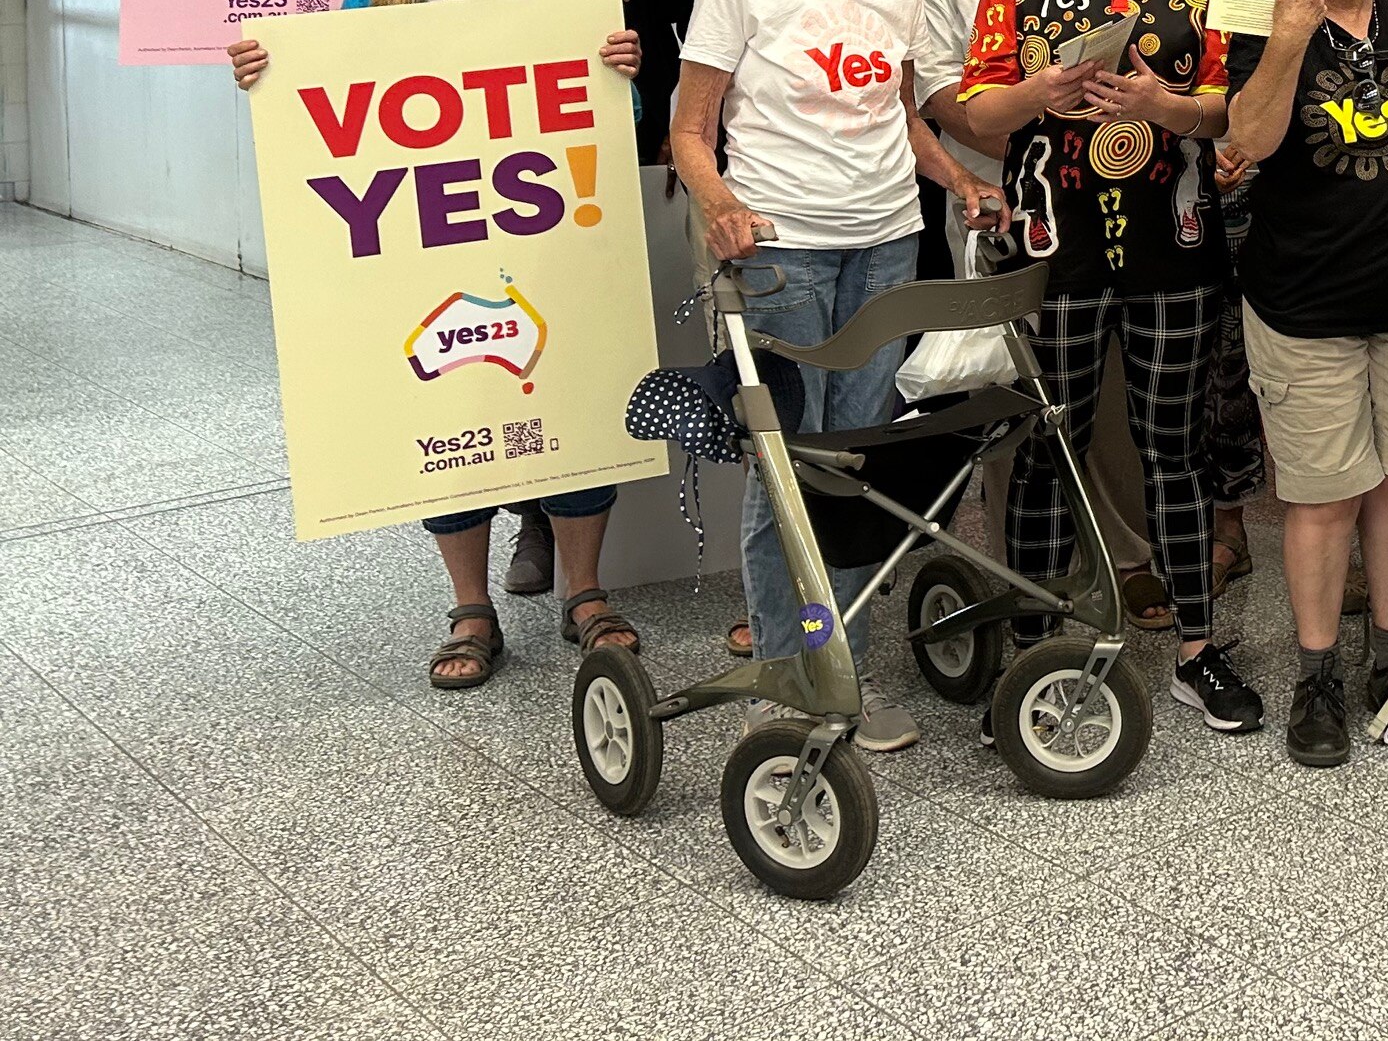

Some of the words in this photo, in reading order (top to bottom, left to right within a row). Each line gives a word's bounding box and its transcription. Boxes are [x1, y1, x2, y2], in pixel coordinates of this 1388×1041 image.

[803, 42, 892, 92] Yes
[297, 59, 595, 158] VOTE
[307, 144, 603, 258] YES!
[437, 319, 519, 353] yes23
[416, 427, 493, 458] Yes23
[419, 450, 495, 474] .com.au
[801, 619, 824, 633] Yes
